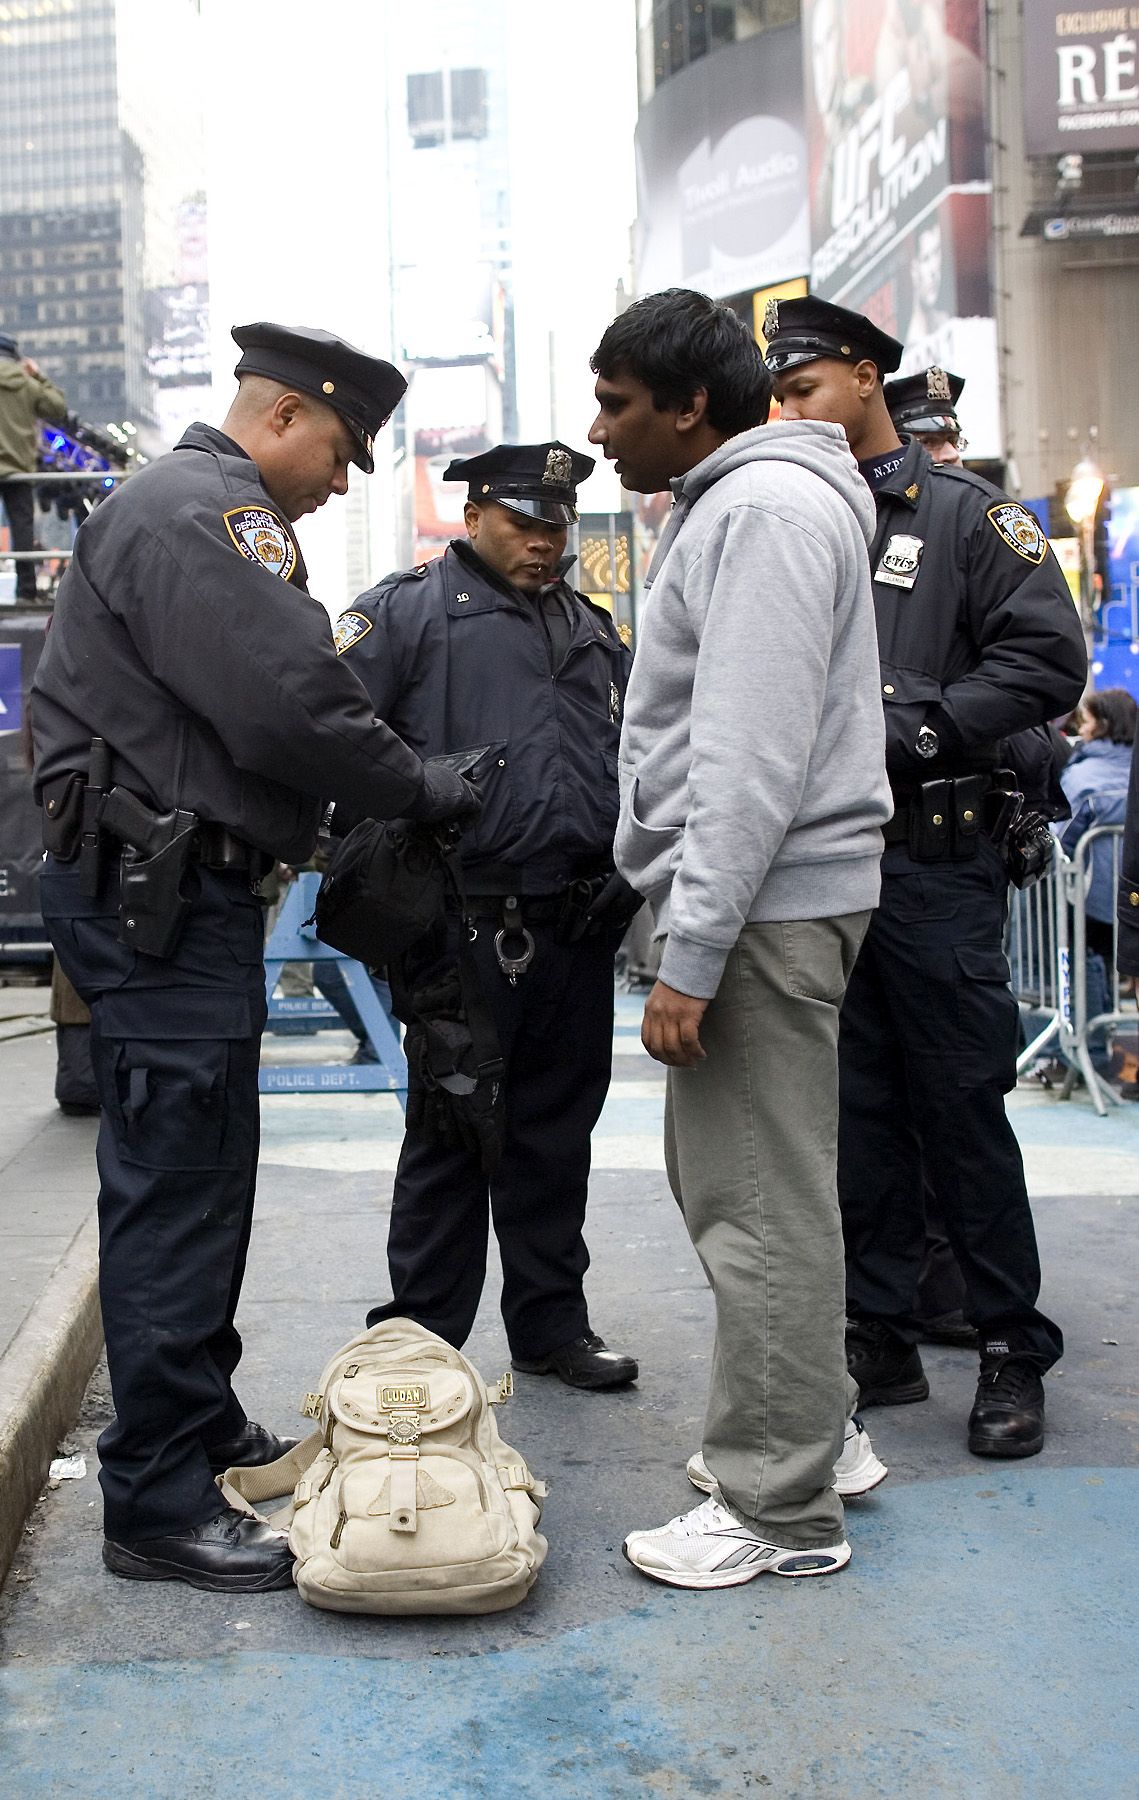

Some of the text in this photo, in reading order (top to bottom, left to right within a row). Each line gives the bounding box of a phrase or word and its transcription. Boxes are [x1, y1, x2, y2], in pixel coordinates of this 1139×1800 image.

[831, 69, 911, 229] UFC
[684, 169, 730, 211] Tivoli
[734, 151, 799, 189] Audio
[243, 511, 274, 525] POLICE
[240, 541, 257, 561] CITY
[278, 1001, 309, 1011] POLICE
[267, 1072, 360, 1087] POLICE DEPT.
